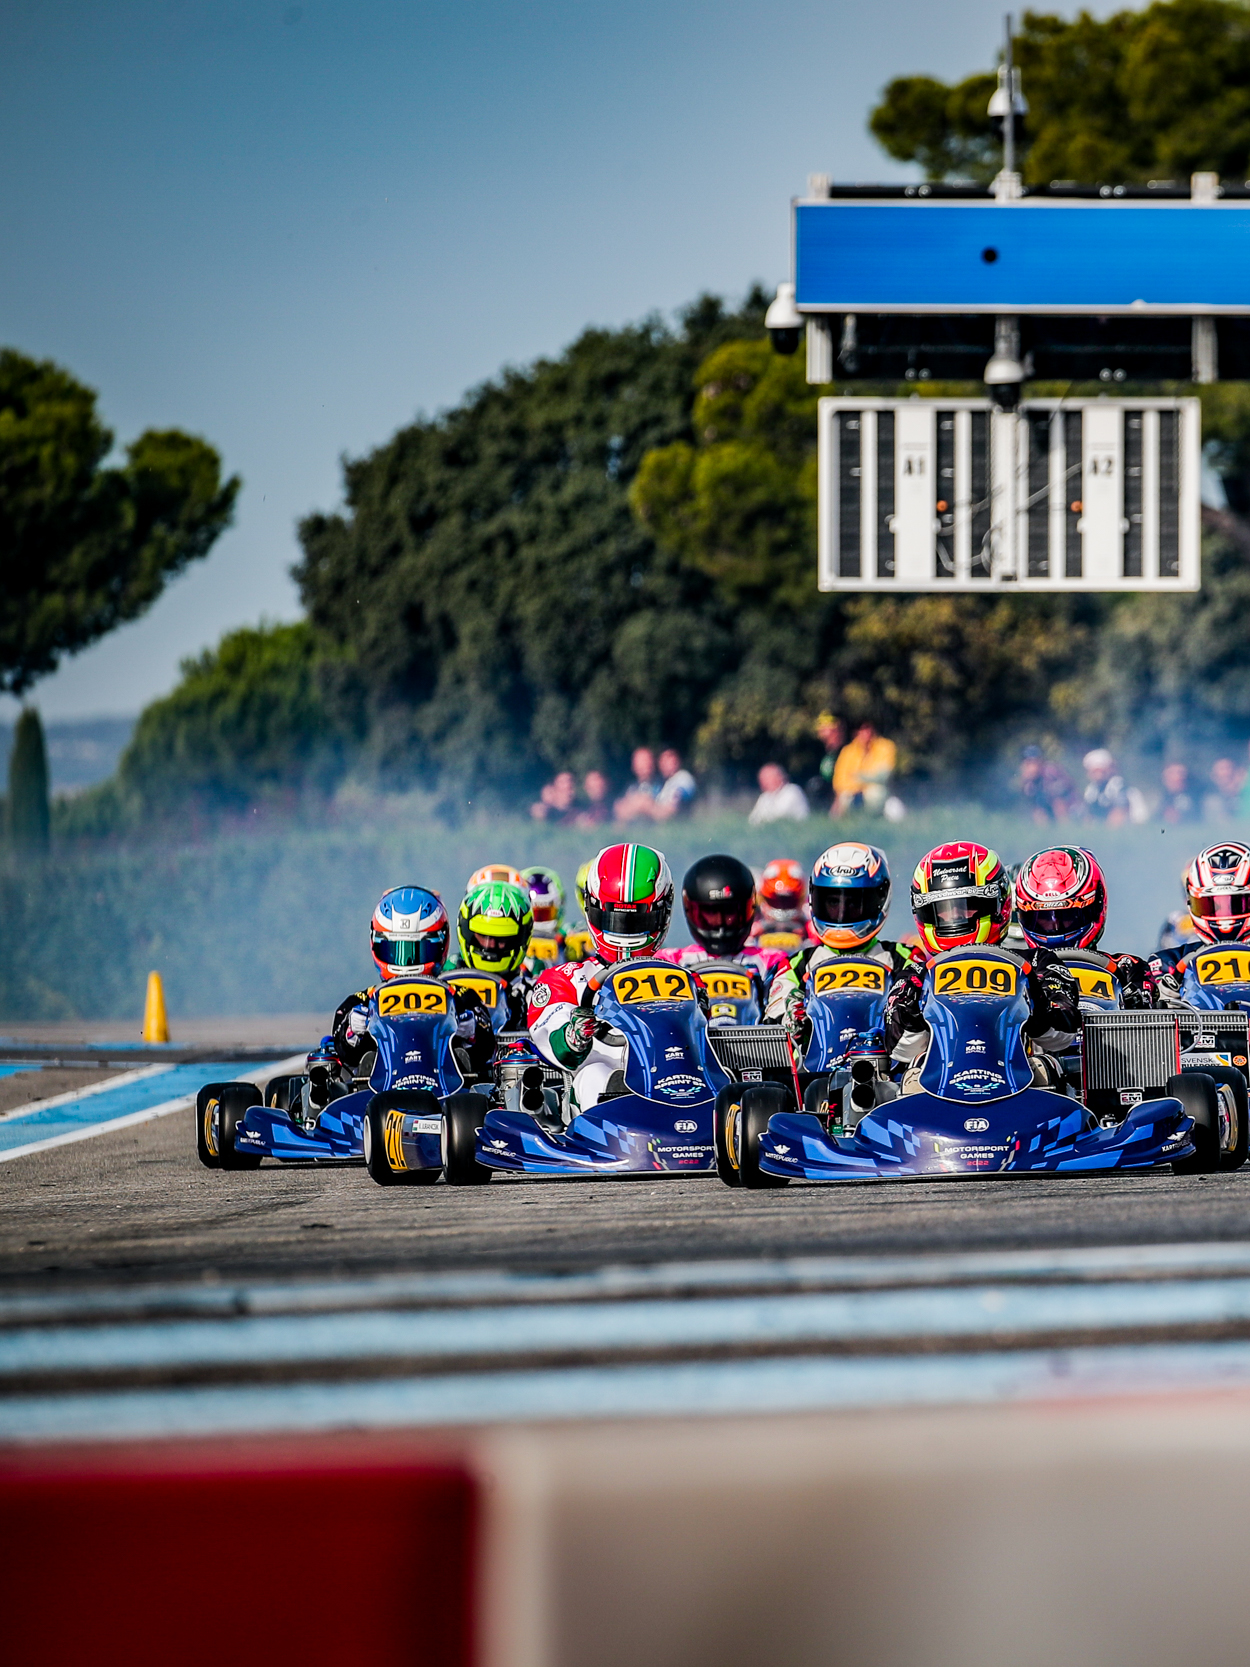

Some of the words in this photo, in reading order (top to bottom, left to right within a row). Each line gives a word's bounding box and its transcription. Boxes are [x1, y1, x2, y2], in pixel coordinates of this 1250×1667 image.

[933, 865, 967, 877] Universal
[817, 969, 882, 993] 223
[938, 966, 1012, 993] 209
[618, 974, 690, 1001] 212
[702, 979, 748, 996] 05
[382, 992, 443, 1014] 202
[396, 1074, 436, 1084] KARTING
[657, 1074, 703, 1084] KARTING
[953, 1068, 1003, 1079] KARTING
[654, 1080, 692, 1090] SPRINT
[949, 1074, 989, 1085] SPRINT
[675, 1122, 697, 1132] FIA
[966, 1120, 988, 1131] FIA
[657, 1145, 716, 1153] MOTORSPORT
[944, 1145, 1010, 1153] MOTORSPORT
[960, 1152, 995, 1160] GAMES
